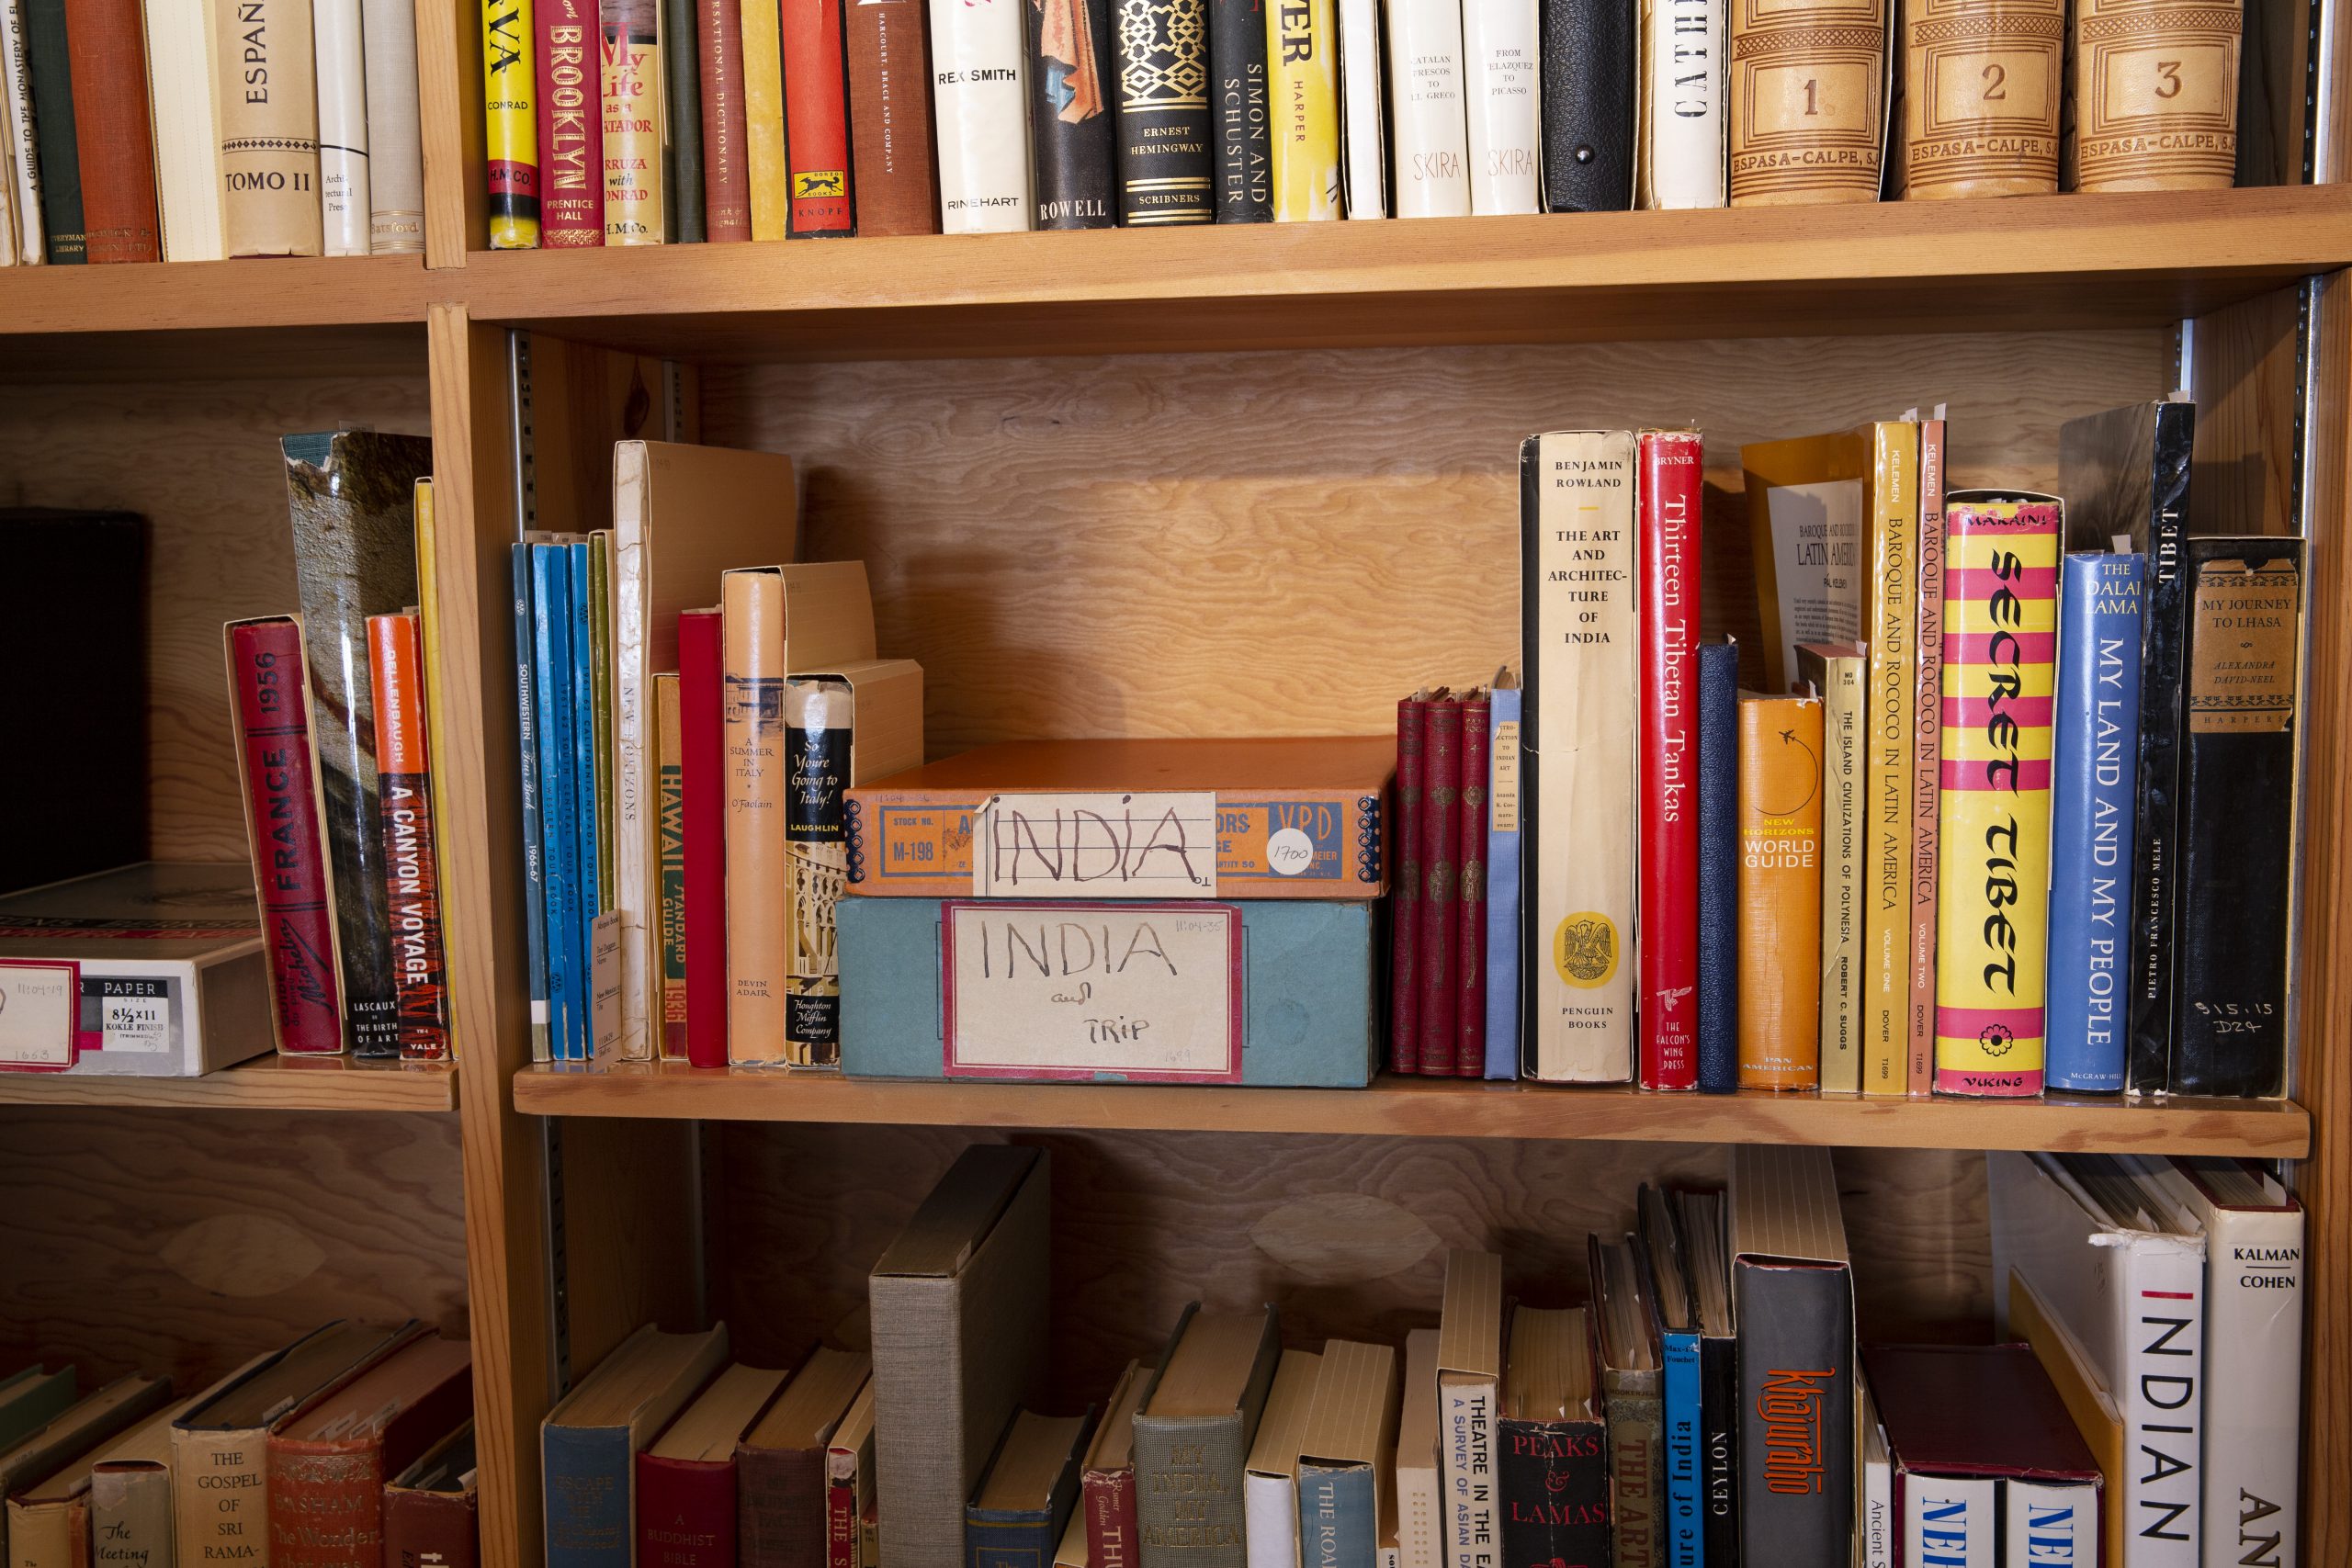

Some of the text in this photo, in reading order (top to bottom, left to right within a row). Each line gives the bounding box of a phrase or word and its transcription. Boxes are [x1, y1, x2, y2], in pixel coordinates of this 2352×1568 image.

[12, 19, 20, 35] OF
[601, 21, 647, 73] My
[13, 42, 28, 100] MONASTERY
[938, 69, 1016, 85] REX SMITH
[2154, 60, 2182, 99] 3
[881, 70, 890, 101] BRACE
[1981, 62, 2007, 101] 2
[487, 100, 529, 111] CONRAD
[549, 25, 587, 190] BROOKLYN
[1294, 80, 1306, 143] HARPER
[21, 106, 31, 123] THE
[883, 105, 891, 125] AND
[23, 129, 32, 144] TO
[717, 92, 728, 184] DICTIONARY
[1143, 126, 1191, 138] ERNEST
[1247, 63, 1267, 203] SIMON AND
[1130, 142, 1204, 156] HEMINGWAY
[1224, 78, 1245, 204] SCHUSTER
[884, 129, 894, 175] COMPANY
[24, 147, 36, 180] GUIDE
[1413, 152, 1461, 182] SKIRA
[1487, 148, 1534, 177] SKIRA
[225, 171, 311, 193] TOMO II
[547, 199, 594, 210] PRENTICE
[947, 197, 1020, 210] RINEHART
[1138, 193, 1201, 205] SCRIBNERS
[556, 211, 583, 221] HALL
[797, 208, 843, 218] KNOPF
[1040, 198, 1107, 221] ROWELL
[1555, 460, 1623, 473] BENJAMIN
[1927, 444, 1937, 497] KELEMEN
[1555, 478, 1622, 488] ROWLAND
[1891, 449, 1902, 503] KELEMEN
[1555, 530, 1621, 542] THE ART
[2158, 507, 2180, 585] TIBET
[1572, 549, 1606, 561] AND
[1547, 570, 1628, 582] ARCHITEC-
[2101, 563, 2132, 576] THE
[1567, 591, 1609, 603] TURE
[2086, 580, 2142, 597] DALAI
[2202, 598, 2292, 612] MY JOURNEY
[1578, 612, 1599, 624] OF
[2212, 616, 2282, 629] TO LHASA
[1565, 633, 1611, 644] INDIA
[1664, 493, 1688, 823] Thirteen Tibetan Tankas
[2212, 660, 2277, 671] ALEXANDRA
[2213, 675, 2276, 685] DAVID-NEEL
[384, 649, 404, 763] DELLENBAUGH
[1883, 517, 1904, 911] BAROQUE AND ROCOCO IN LATIN AMERICA
[2204, 715, 2284, 725] HARPERS
[729, 747, 775, 757] SUMMER
[254, 651, 302, 891] FRANCE 1956
[519, 663, 538, 883] SOUTHWESTERN Tour Book 1966-67
[1983, 547, 2023, 998] SECRET TIBET
[799, 789, 833, 810] Italy!
[661, 770, 684, 873] HAWAII
[790, 823, 839, 832] LAUGHLIN
[1840, 710, 1853, 944] THE ISLAND CIVILIZATIONS OF POLYNESIA
[1745, 840, 1815, 854] WORLD
[2086, 637, 2124, 1046] MY LAND AND MY PEOPLE
[893, 841, 934, 862] M-198
[1273, 845, 1308, 862] 1700
[1745, 854, 1814, 868] GUIDE
[390, 786, 429, 985] A CANYON VOYAGE
[673, 883, 686, 964] STANDARD
[980, 920, 1179, 978] INDIA
[279, 917, 336, 1018] Michelin
[104, 982, 156, 995] PAPER
[738, 979, 767, 987] DEVIN
[1049, 980, 1092, 1006] and
[353, 1001, 397, 1011] LASCAUX
[1561, 1007, 1614, 1016] PENGUIN
[356, 1022, 398, 1032] THE BIRTH
[1567, 1021, 1608, 1030] BOOKS
[1665, 1021, 1680, 1032] THE
[1882, 1010, 1890, 1043] DOVER
[1916, 1004, 1924, 1038] DOVER
[357, 1033, 400, 1043] OF ART
[410, 1043, 437, 1051] YALE
[1663, 1047, 1684, 1057] WING
[1663, 1059, 1685, 1070] PRESS
[2233, 1247, 2301, 1262] KALMAN
[2239, 1275, 2296, 1290] COHEN
[1666, 1355, 1696, 1364] Fouchet
[2138, 1290, 2195, 1542] INDIAN
[1512, 1434, 1600, 1458] PEAKS
[210, 1452, 244, 1466] THE
[1453, 1398, 1471, 1547] A SURVEY OF ASIAN
[1470, 1394, 1490, 1545] THEATRE IN THE
[1671, 1420, 1694, 1517] of India
[1712, 1431, 1728, 1516] CEYLON
[198, 1473, 263, 1489] GOSPEL
[218, 1499, 241, 1513] OF
[1317, 1482, 1335, 1520] THE
[1617, 1438, 1649, 1568] THE ART
[1510, 1500, 1607, 1526] LAMAS
[100, 1520, 132, 1540] The
[217, 1522, 243, 1536] SRI
[832, 1506, 848, 1543] THE
[1871, 1499, 1885, 1555] Ancient
[646, 1529, 718, 1548] BUDDHIST
[203, 1545, 260, 1560] RAMA-
[662, 1551, 698, 1566] BIBLE
